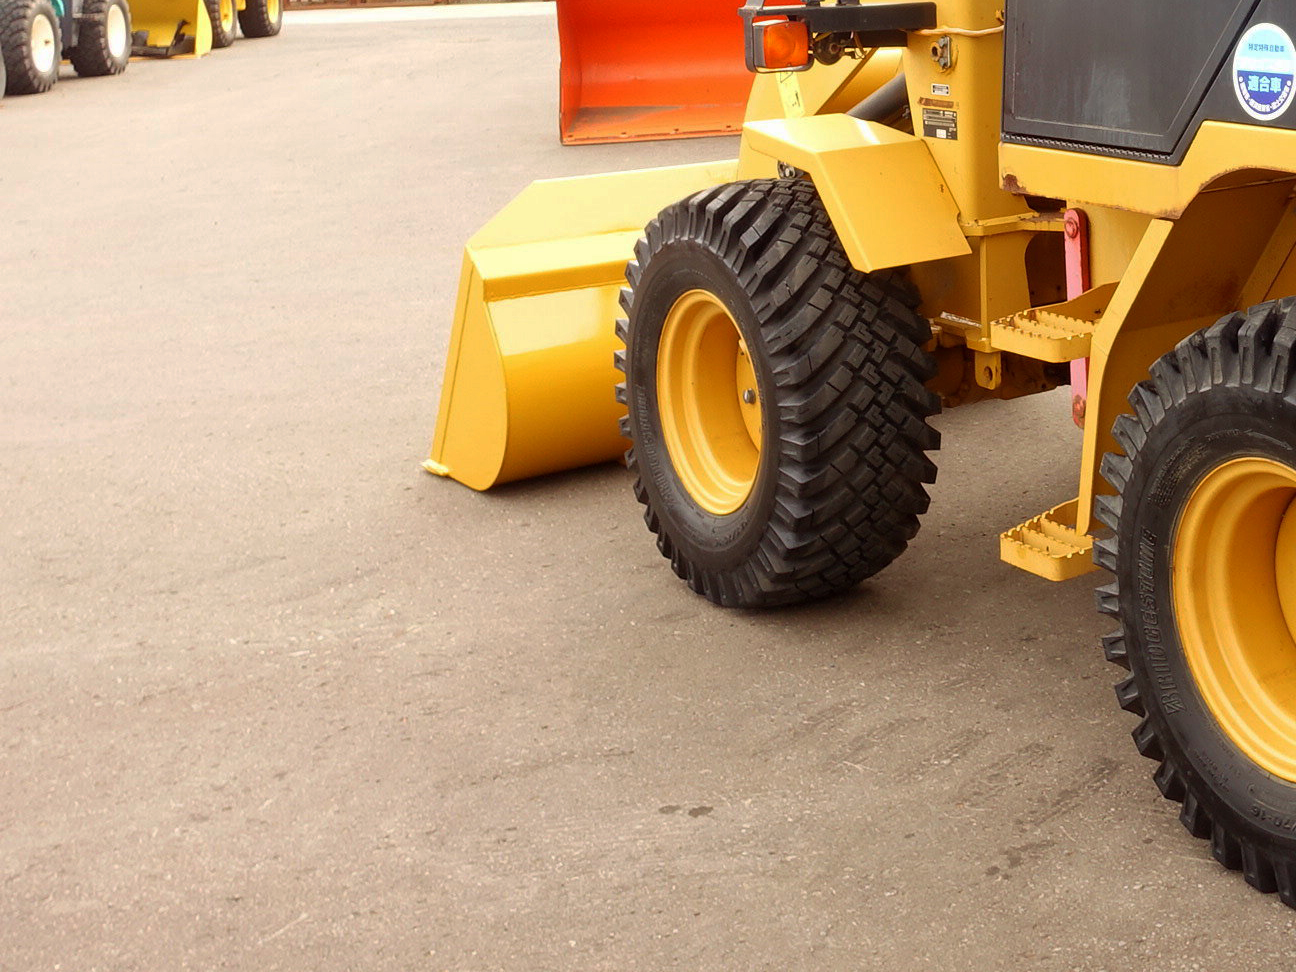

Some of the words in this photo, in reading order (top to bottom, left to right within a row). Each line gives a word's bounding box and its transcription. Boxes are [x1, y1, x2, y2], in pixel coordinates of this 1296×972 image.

[1247, 74, 1282, 94] 適合車
[1135, 525, 1186, 716] BRIDGESTONE
